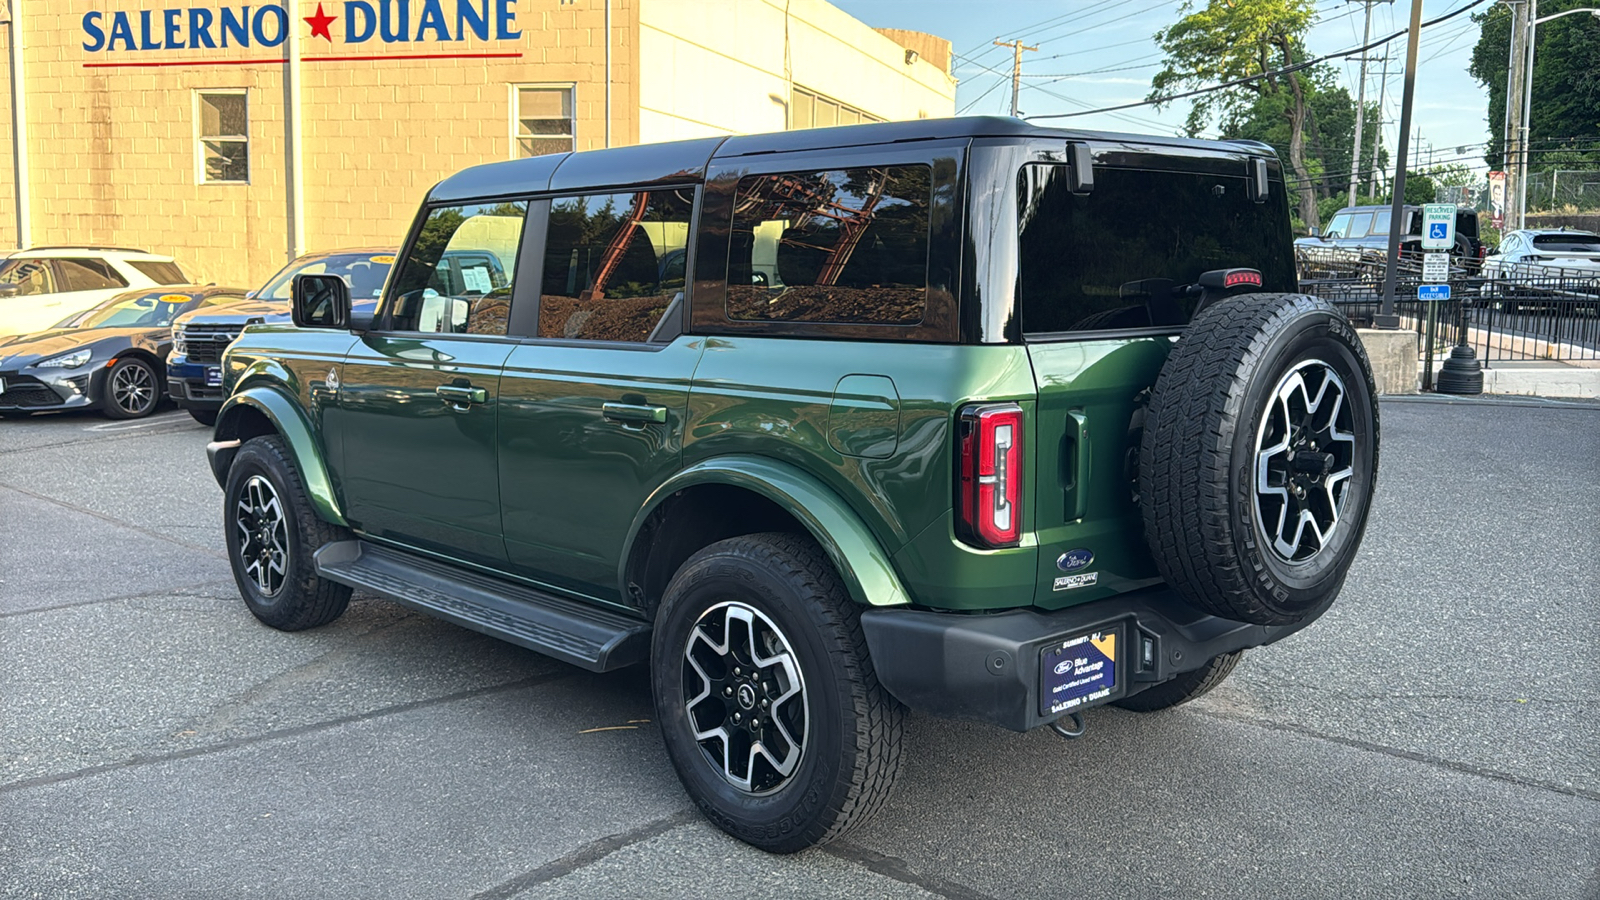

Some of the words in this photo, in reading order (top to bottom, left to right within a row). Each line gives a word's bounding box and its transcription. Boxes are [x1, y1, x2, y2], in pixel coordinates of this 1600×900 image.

[82, 5, 288, 52] SALERNO
[344, 0, 523, 43] DUANE
[1074, 657, 1088, 667] Blue
[1074, 661, 1104, 676] Advantage
[1062, 680, 1080, 690] Certified
[1080, 676, 1091, 685] Used
[1051, 697, 1081, 714] SALERNO
[1088, 687, 1111, 701] DUANE
